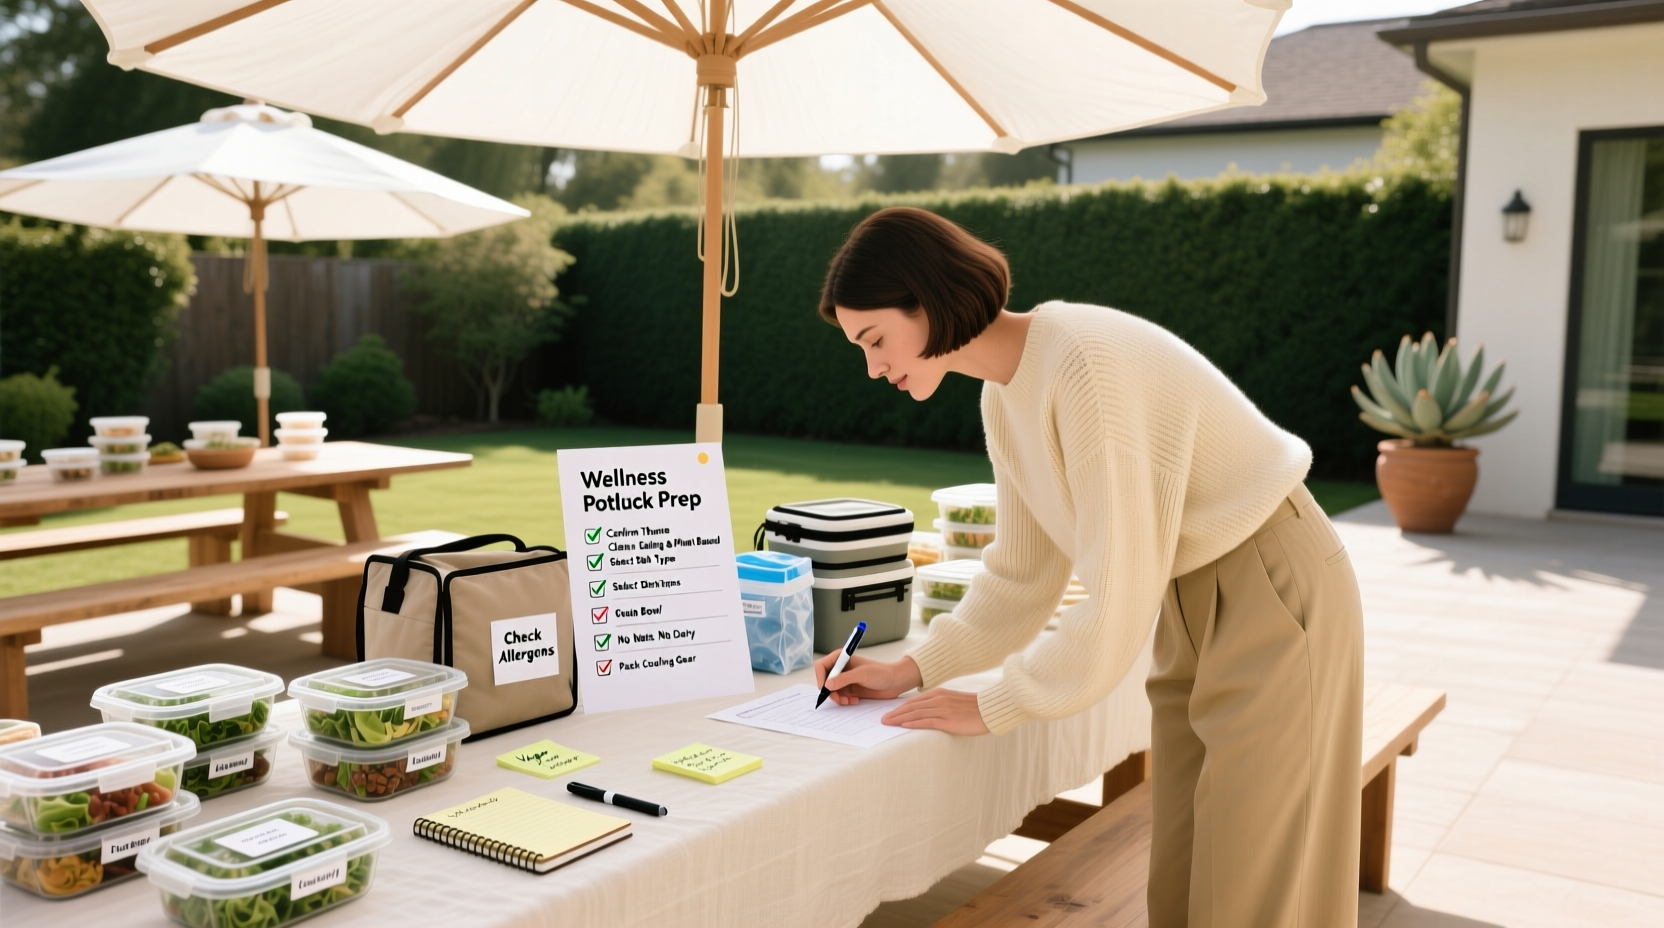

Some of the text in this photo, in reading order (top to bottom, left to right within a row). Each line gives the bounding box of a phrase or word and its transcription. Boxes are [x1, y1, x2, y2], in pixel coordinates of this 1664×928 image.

[580, 468, 667, 488] Wellness
[583, 490, 702, 512] Potluck Prep
[504, 627, 542, 645] Check
[617, 634, 631, 645] No
